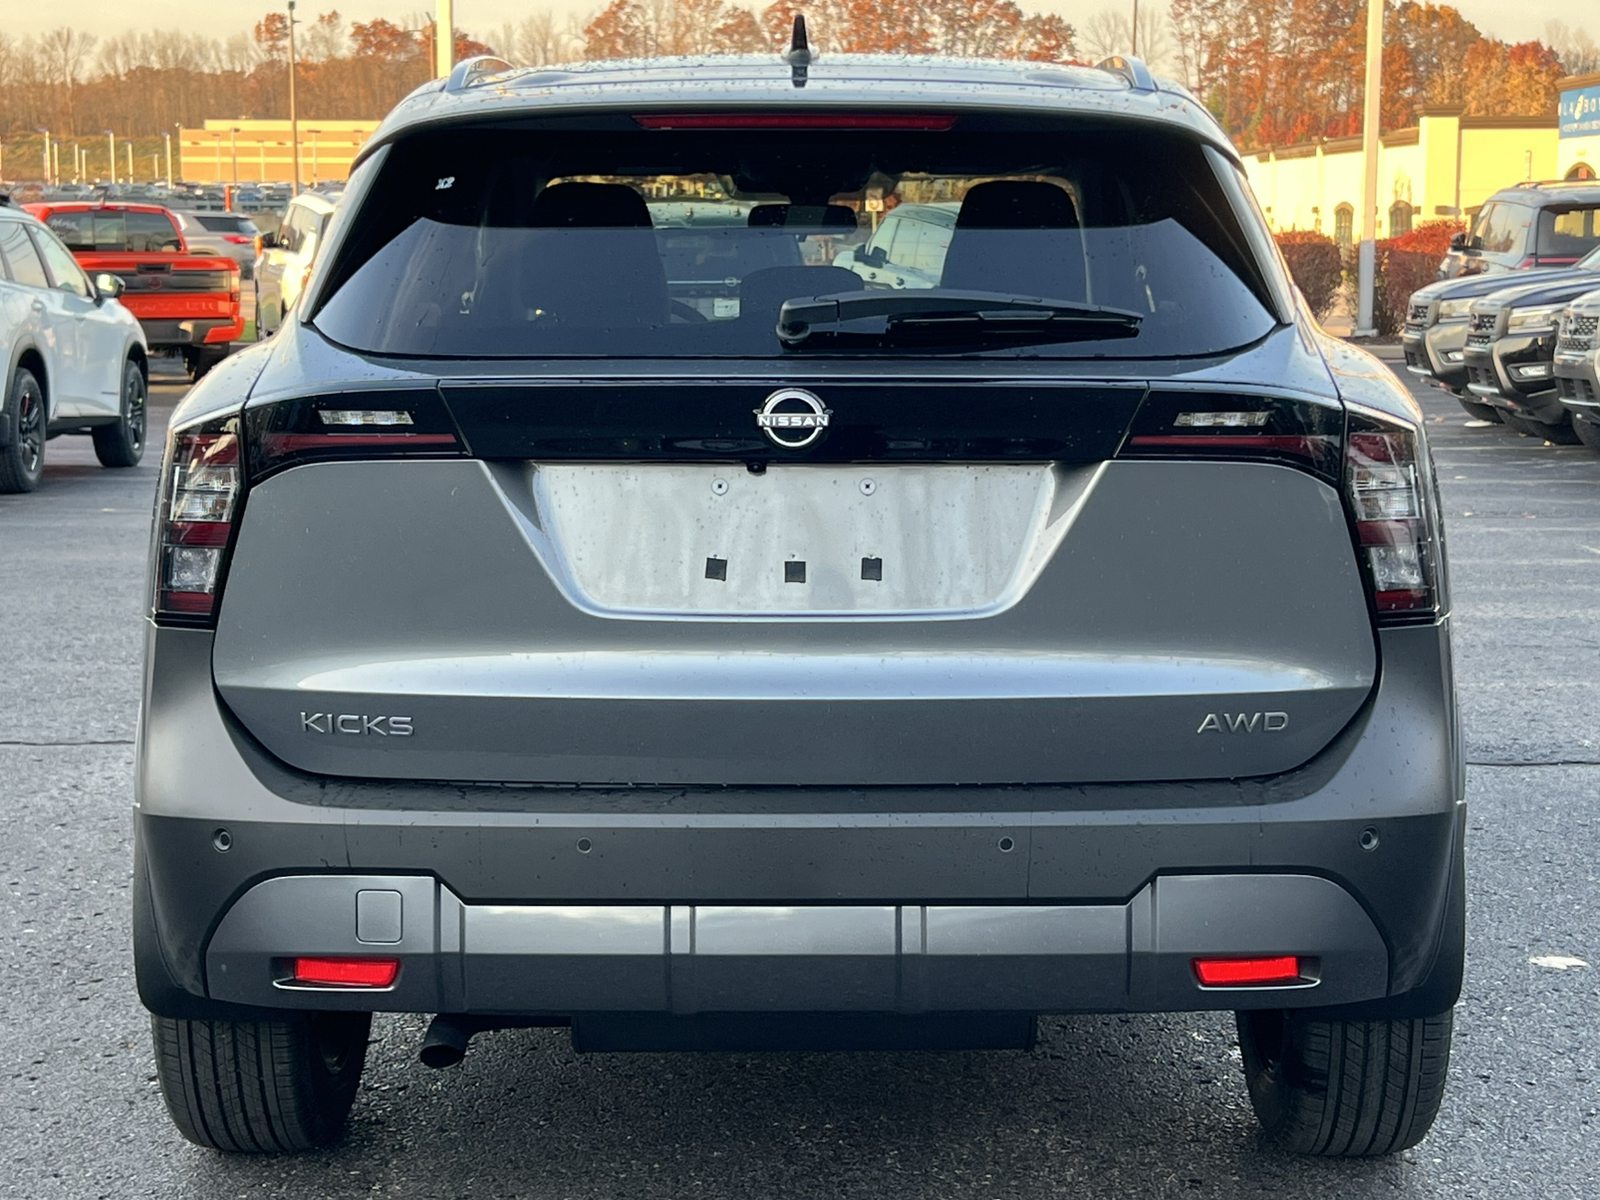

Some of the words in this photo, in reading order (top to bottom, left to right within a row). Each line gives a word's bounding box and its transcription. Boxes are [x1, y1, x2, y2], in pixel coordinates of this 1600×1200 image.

[758, 416, 828, 427] NISSAN
[300, 711, 414, 736] KICKS
[1196, 711, 1289, 734] AWD
